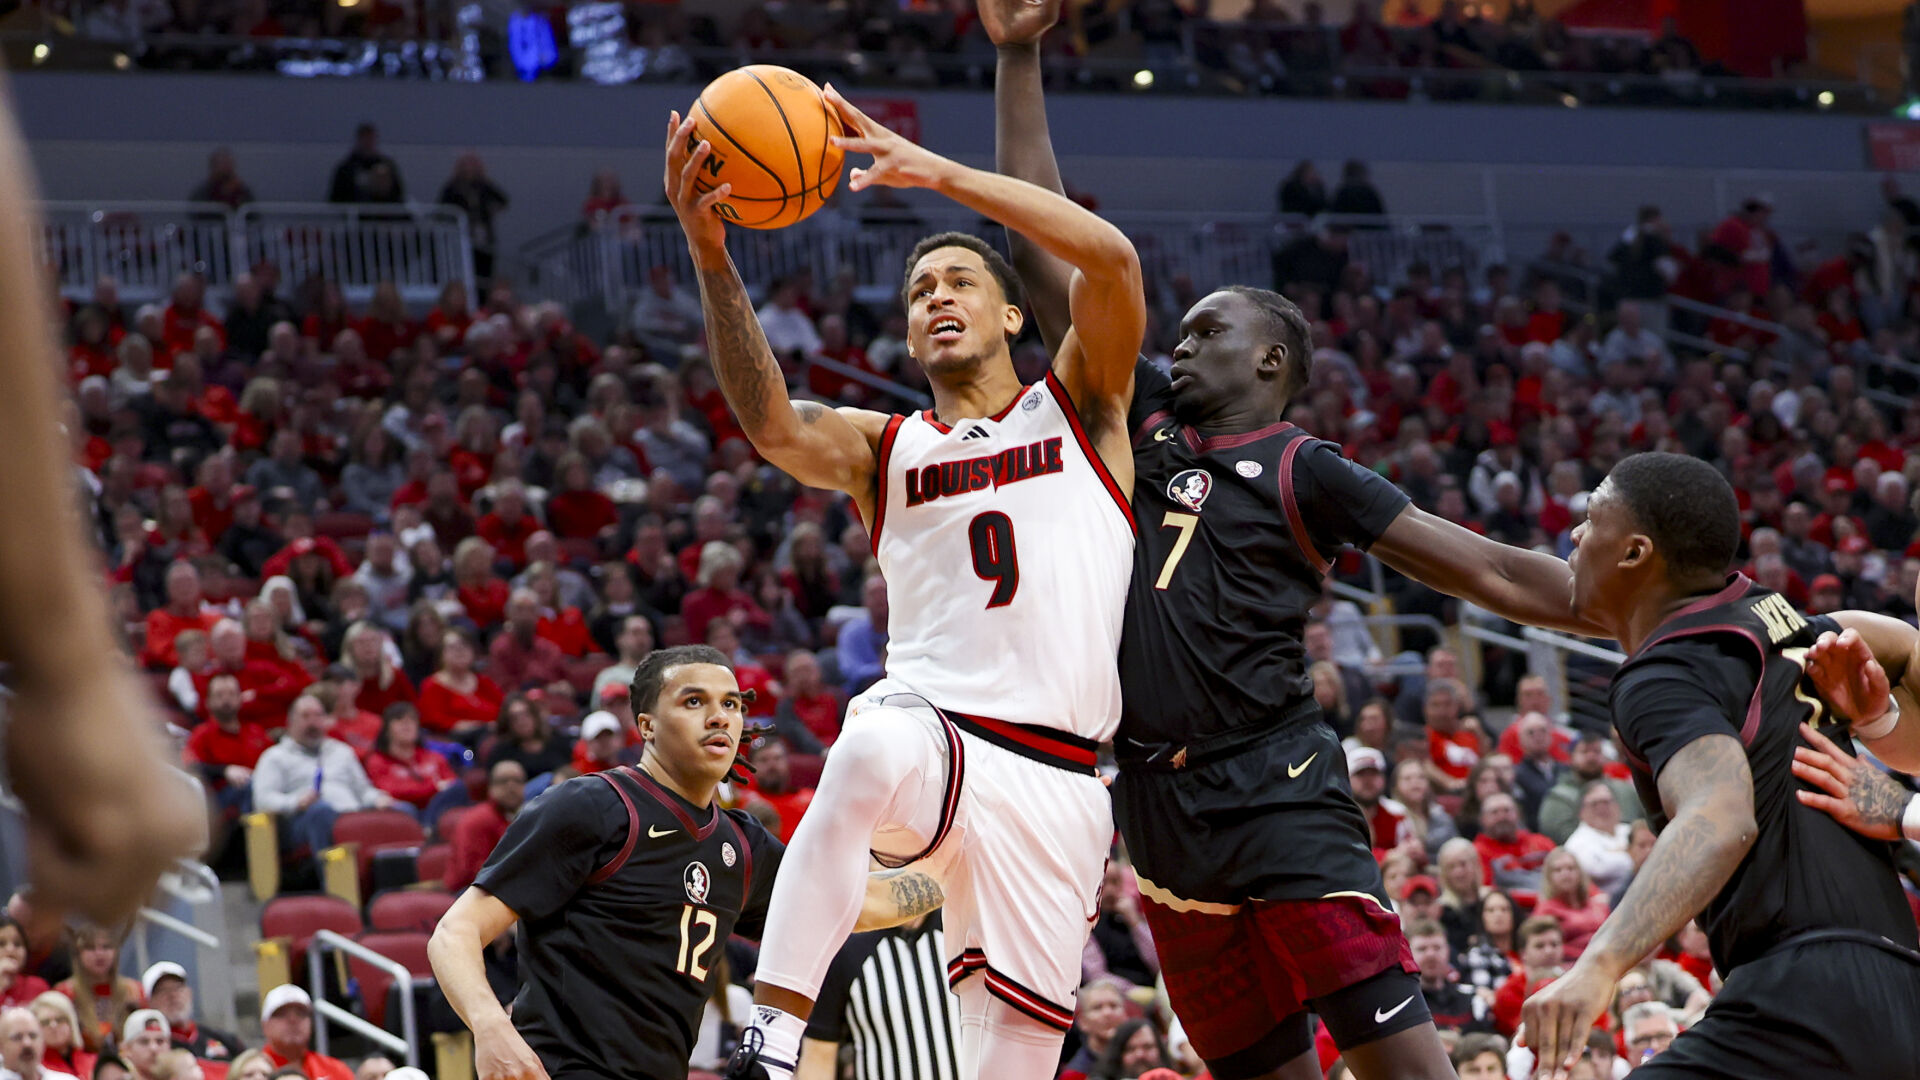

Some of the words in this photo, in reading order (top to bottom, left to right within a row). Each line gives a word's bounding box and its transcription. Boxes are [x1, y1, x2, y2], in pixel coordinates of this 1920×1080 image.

[906, 436, 1063, 508] LOUISVILLE
[968, 511, 1019, 610] 9
[1154, 510, 1201, 591] 7
[675, 902, 718, 983] 12
